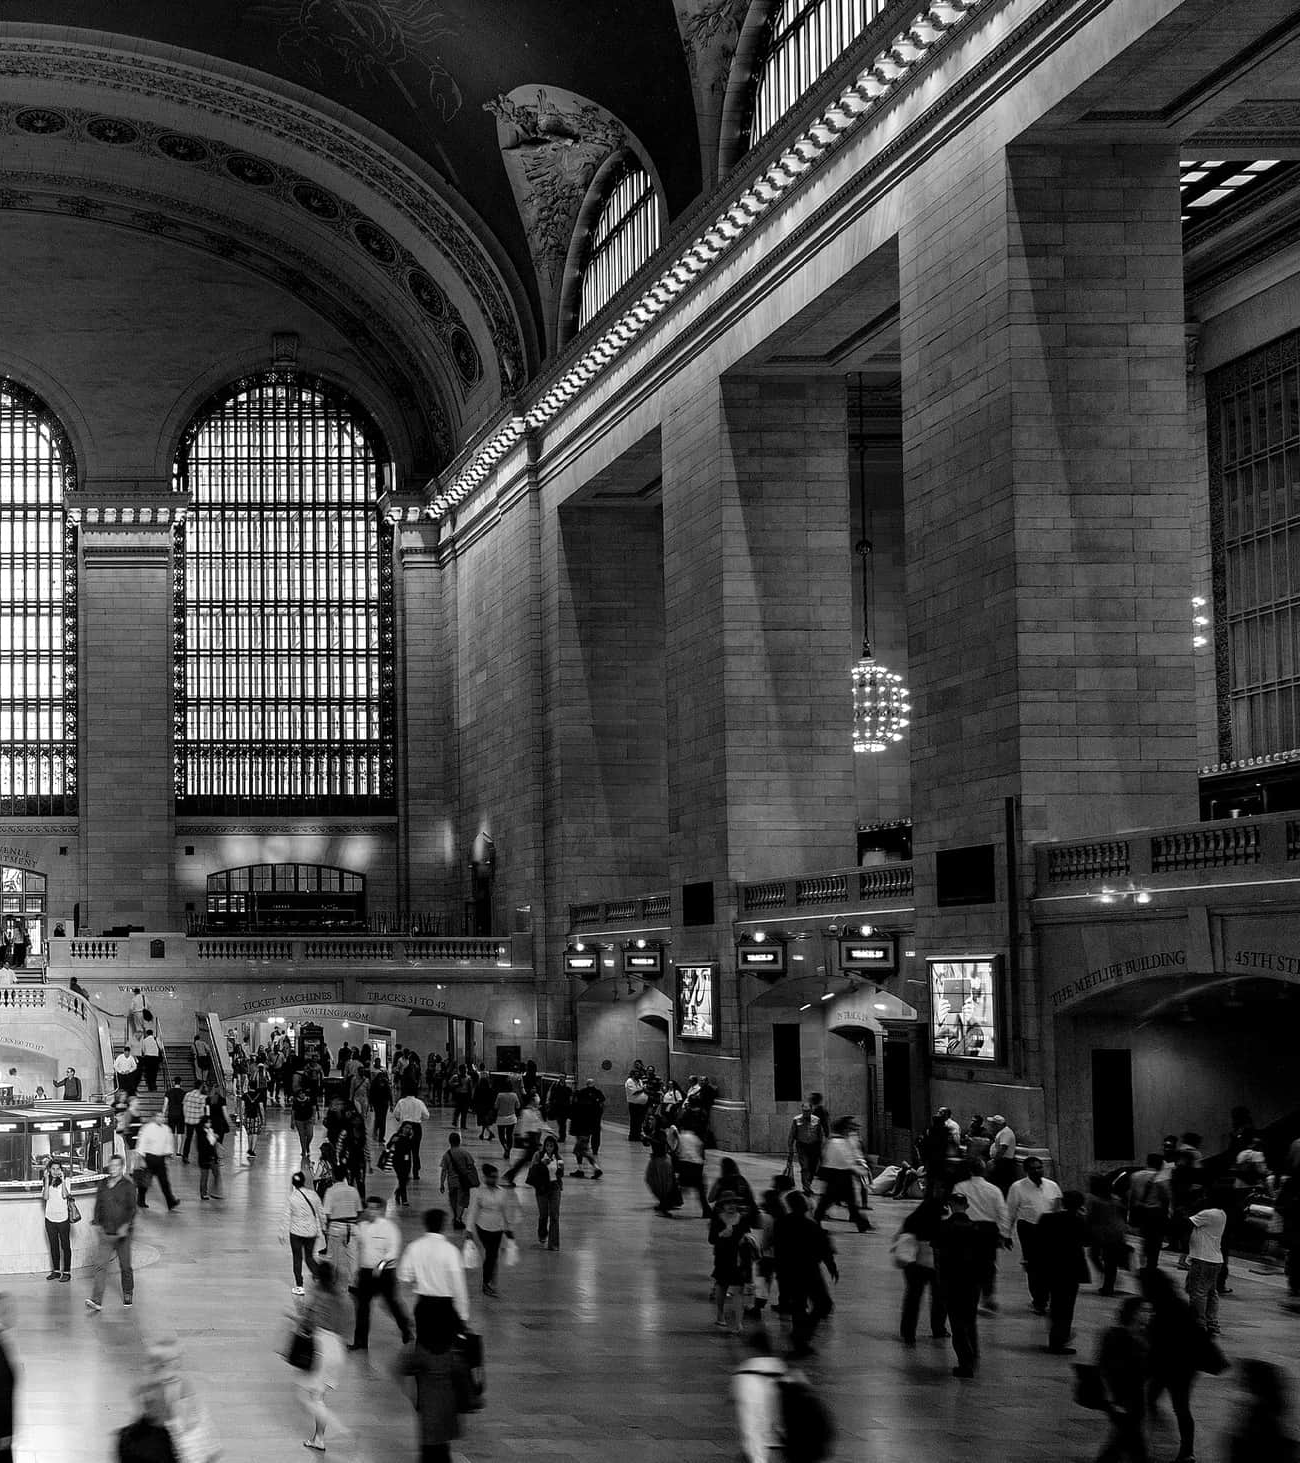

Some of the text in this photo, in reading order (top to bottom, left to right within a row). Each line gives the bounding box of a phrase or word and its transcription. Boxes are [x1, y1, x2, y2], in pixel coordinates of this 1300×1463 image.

[1234, 950, 1275, 970] 45TH
[1051, 951, 1185, 1006] THE METLIFE BUILDING
[243, 991, 332, 1011] TICKET MACHINES
[367, 991, 406, 1003] TRACKS
[419, 997, 434, 1007] TO
[302, 1006, 341, 1018] WAITING
